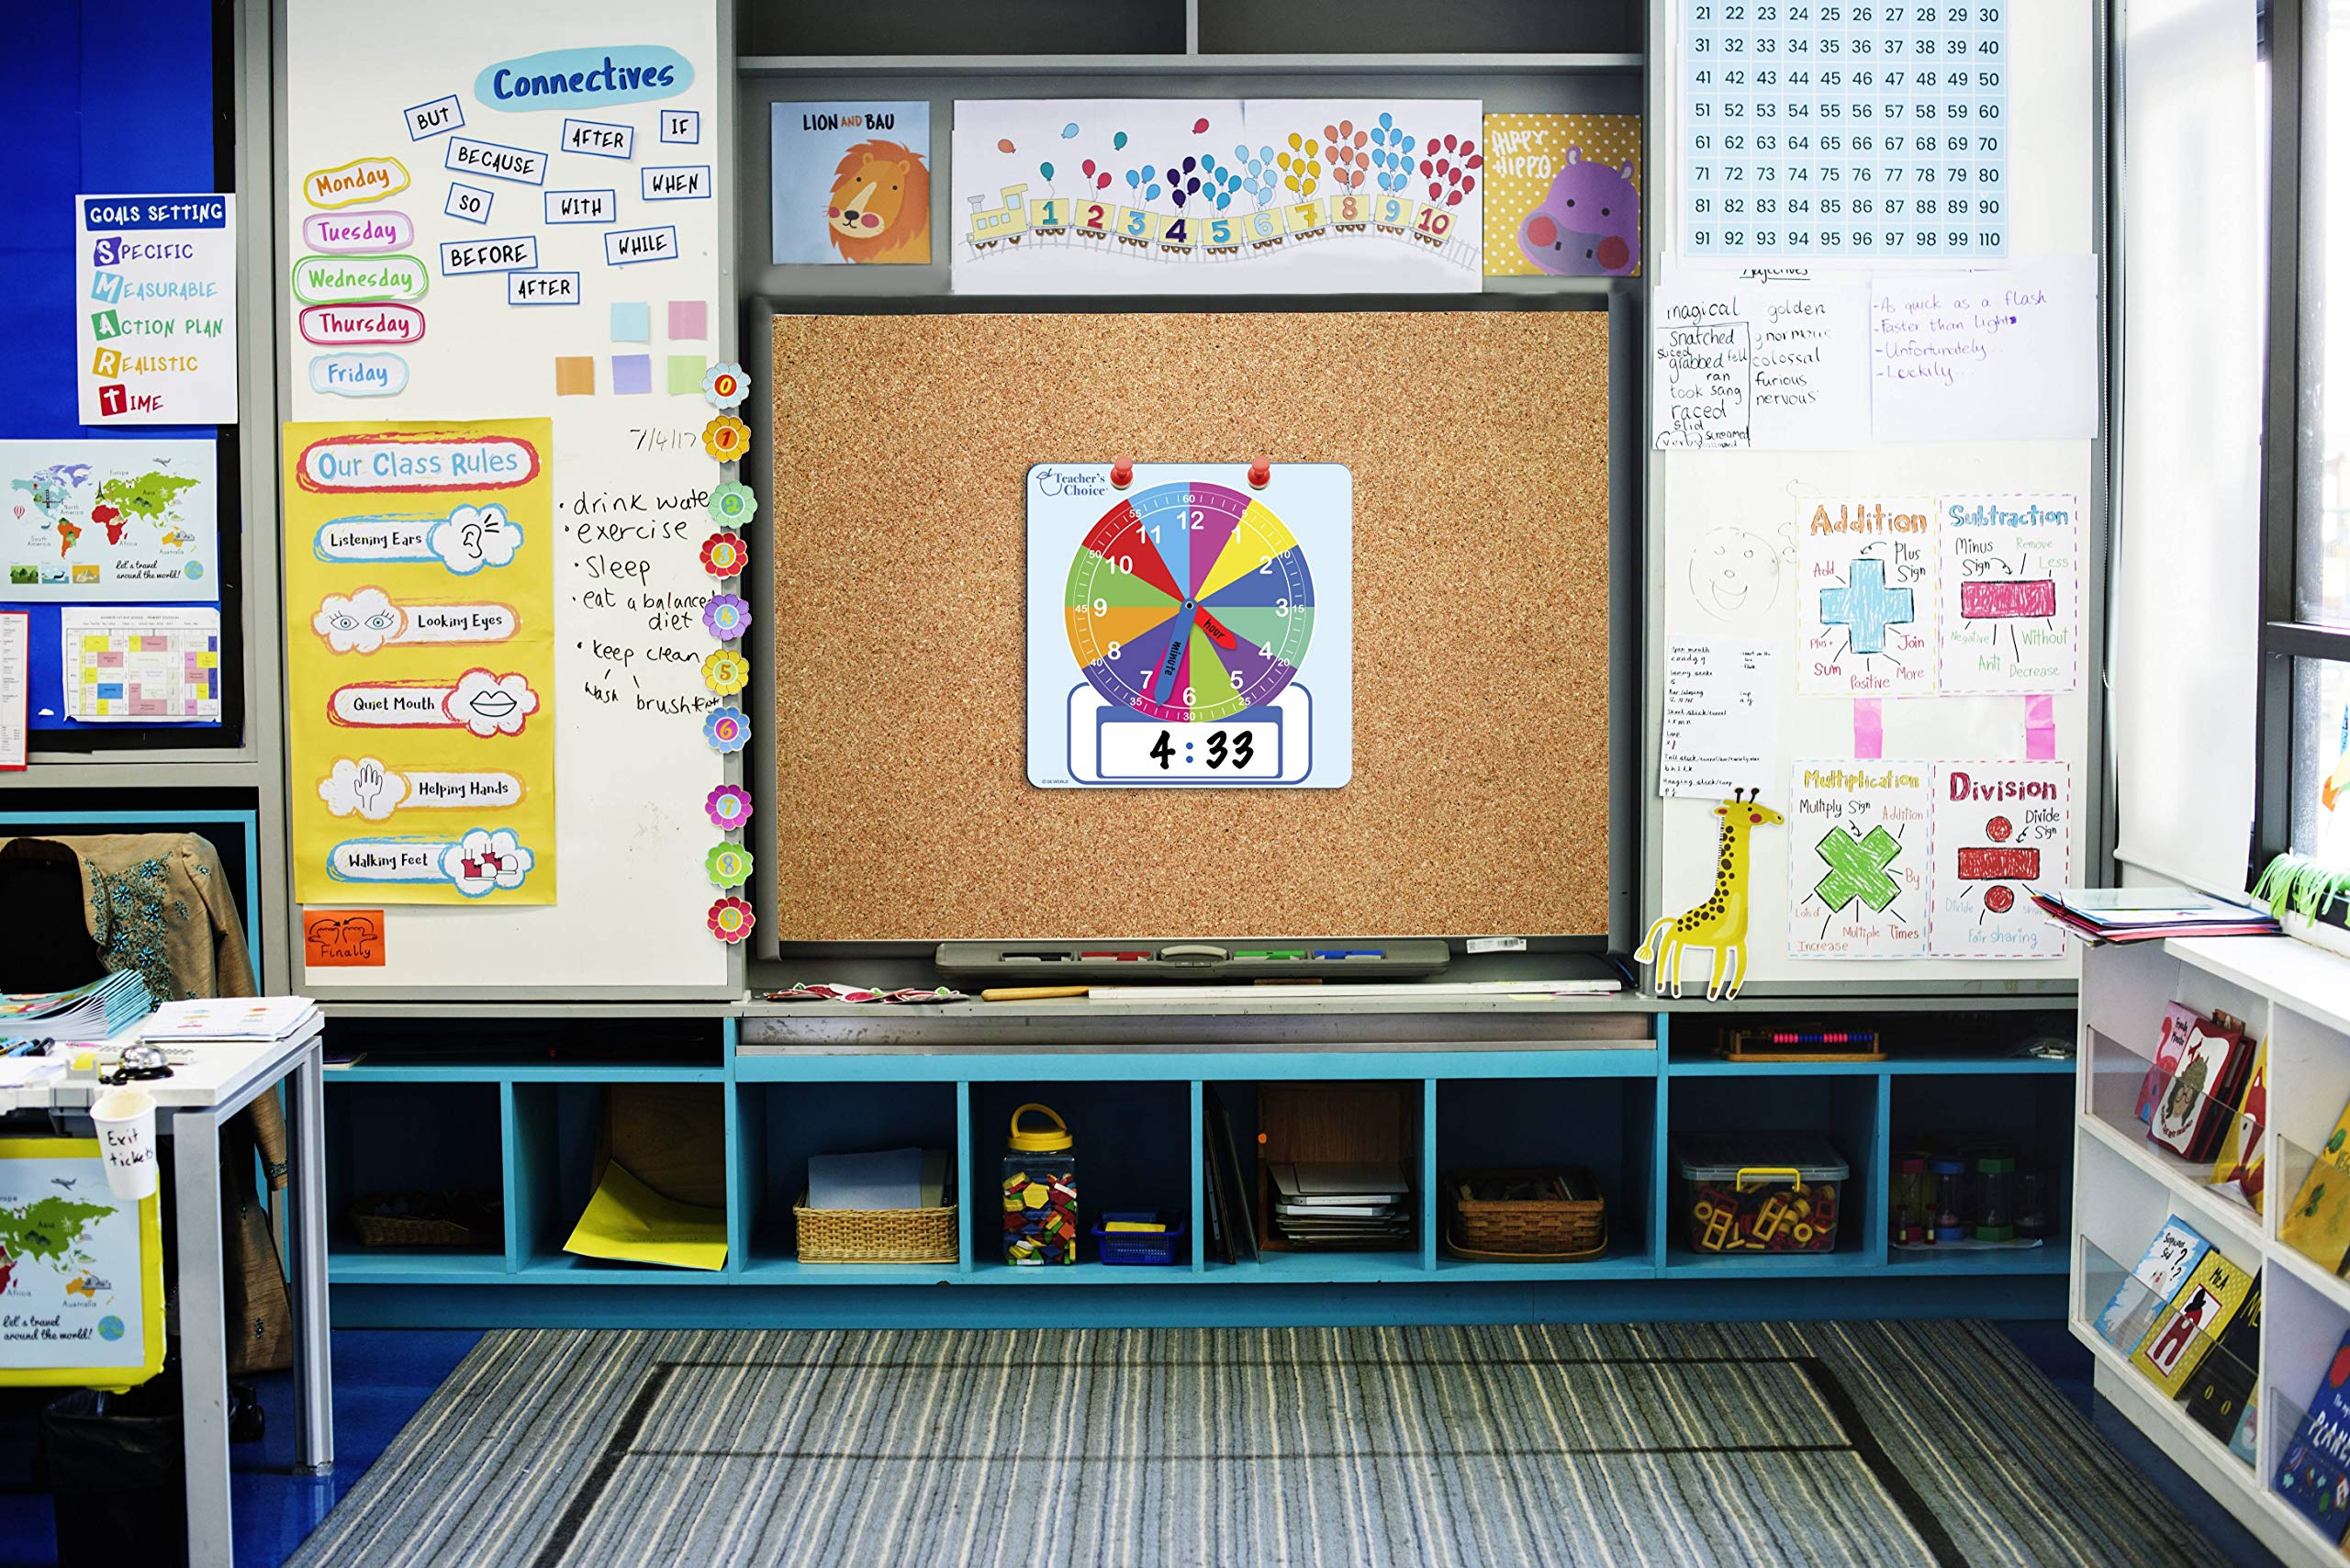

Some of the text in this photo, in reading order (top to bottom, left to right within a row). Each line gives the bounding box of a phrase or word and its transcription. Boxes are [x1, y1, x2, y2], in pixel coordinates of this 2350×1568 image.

[494, 57, 675, 100] Connectives
[418, 107, 449, 129] BUT
[672, 118, 688, 135] IF
[803, 114, 894, 130] LION AND BAU
[573, 128, 623, 148] AFTER
[458, 146, 534, 175] BECAUSE
[1496, 154, 1550, 178] HIPPO
[317, 168, 389, 196] Monday
[654, 174, 699, 193] WHEN
[459, 195, 480, 212] SO
[562, 199, 602, 216] WITH
[90, 203, 222, 225] GOALS SETTING
[1042, 197, 1449, 243] 1 2 3 4 5 6 7 8 9 10
[318, 221, 397, 242] Tuesday
[1695, 232, 2000, 247] 91 92 93 94 95 96 97 98 99 110
[96, 241, 194, 263] SPECIFIC
[619, 235, 667, 255] WHILE
[452, 244, 529, 267] BEFORE
[95, 274, 217, 302] MEASURABLE
[309, 268, 413, 291] Wednesday
[519, 280, 570, 297] AFTER
[1667, 296, 1740, 325] magical
[1905, 294, 1942, 314] quick
[1953, 298, 1970, 308] as
[1982, 298, 1990, 307] a
[2005, 290, 2047, 306] flash
[1768, 300, 1826, 323] golden
[99, 314, 222, 338] ACTION PLAN
[319, 313, 409, 336] Thursday
[1930, 319, 1964, 331] than
[100, 351, 197, 375] REALISTIC
[1752, 347, 1820, 366] colossal
[328, 363, 387, 386] Friday
[1669, 353, 1724, 384] grabbed
[1707, 373, 1730, 381] ran
[719, 378, 733, 394] 0
[1755, 372, 1807, 386] furious
[104, 389, 162, 413] TIME
[1671, 384, 1741, 405] took sang
[1756, 391, 1816, 406] nervous
[1672, 399, 1726, 420] raced
[721, 431, 732, 445] 1
[319, 451, 518, 480] Our Class Rules
[1065, 485, 1105, 495] Choice
[1182, 494, 1195, 503] 60
[574, 490, 710, 516] drink wate
[1177, 511, 1204, 531] 12
[1810, 504, 1928, 536] Addition
[1949, 504, 2068, 528] Subtraction
[330, 532, 421, 547] Listening Ears
[577, 520, 688, 543] exercise
[1136, 526, 1160, 543] 11
[1895, 542, 1919, 564] Plus
[1956, 538, 1993, 554] Minus
[2016, 538, 2053, 551] Remove
[718, 547, 730, 564] 3
[1259, 555, 1272, 574] 2
[136, 561, 158, 569] travel
[1105, 556, 1133, 574] 10
[1813, 562, 1834, 577] Add
[1963, 560, 1990, 577] Sign
[143, 571, 155, 579] the
[1897, 565, 1926, 584] Sign
[583, 589, 637, 611] eat a
[1094, 599, 1107, 617] 9
[1276, 599, 1289, 617] 3
[418, 614, 502, 631] Looking Eyes
[648, 612, 694, 632] diet
[1203, 619, 1225, 640] hour
[1897, 634, 1925, 650] Join
[2021, 629, 2068, 645] Without
[593, 641, 700, 668] keep clean
[1108, 641, 1121, 660] 8
[1165, 641, 1181, 676] minute
[720, 665, 732, 680] 5
[1814, 663, 1841, 677] Sum
[1897, 666, 1924, 679] More
[2009, 663, 2060, 678] Decrease
[1850, 674, 1890, 689] Positive
[353, 697, 434, 712] Quiet Mouth
[1183, 687, 1196, 705] 6
[419, 781, 509, 798] Helping Hands
[1804, 770, 1919, 792] Multiplication
[1949, 772, 2056, 802] Division
[1799, 800, 1871, 818] Multiply Sign
[1882, 806, 1923, 822] Addition
[2025, 809, 2060, 823] Divide
[2034, 824, 2057, 839] Sign
[349, 854, 428, 869] Walking Feet
[1906, 868, 1920, 889] By
[1842, 924, 1880, 940] Multiple
[1888, 924, 1919, 940] Times
[1968, 925, 2038, 949] Fair sharing
[320, 944, 370, 960] Finally
[1797, 940, 1848, 952] Increase
[107, 1129, 139, 1147] Exit
